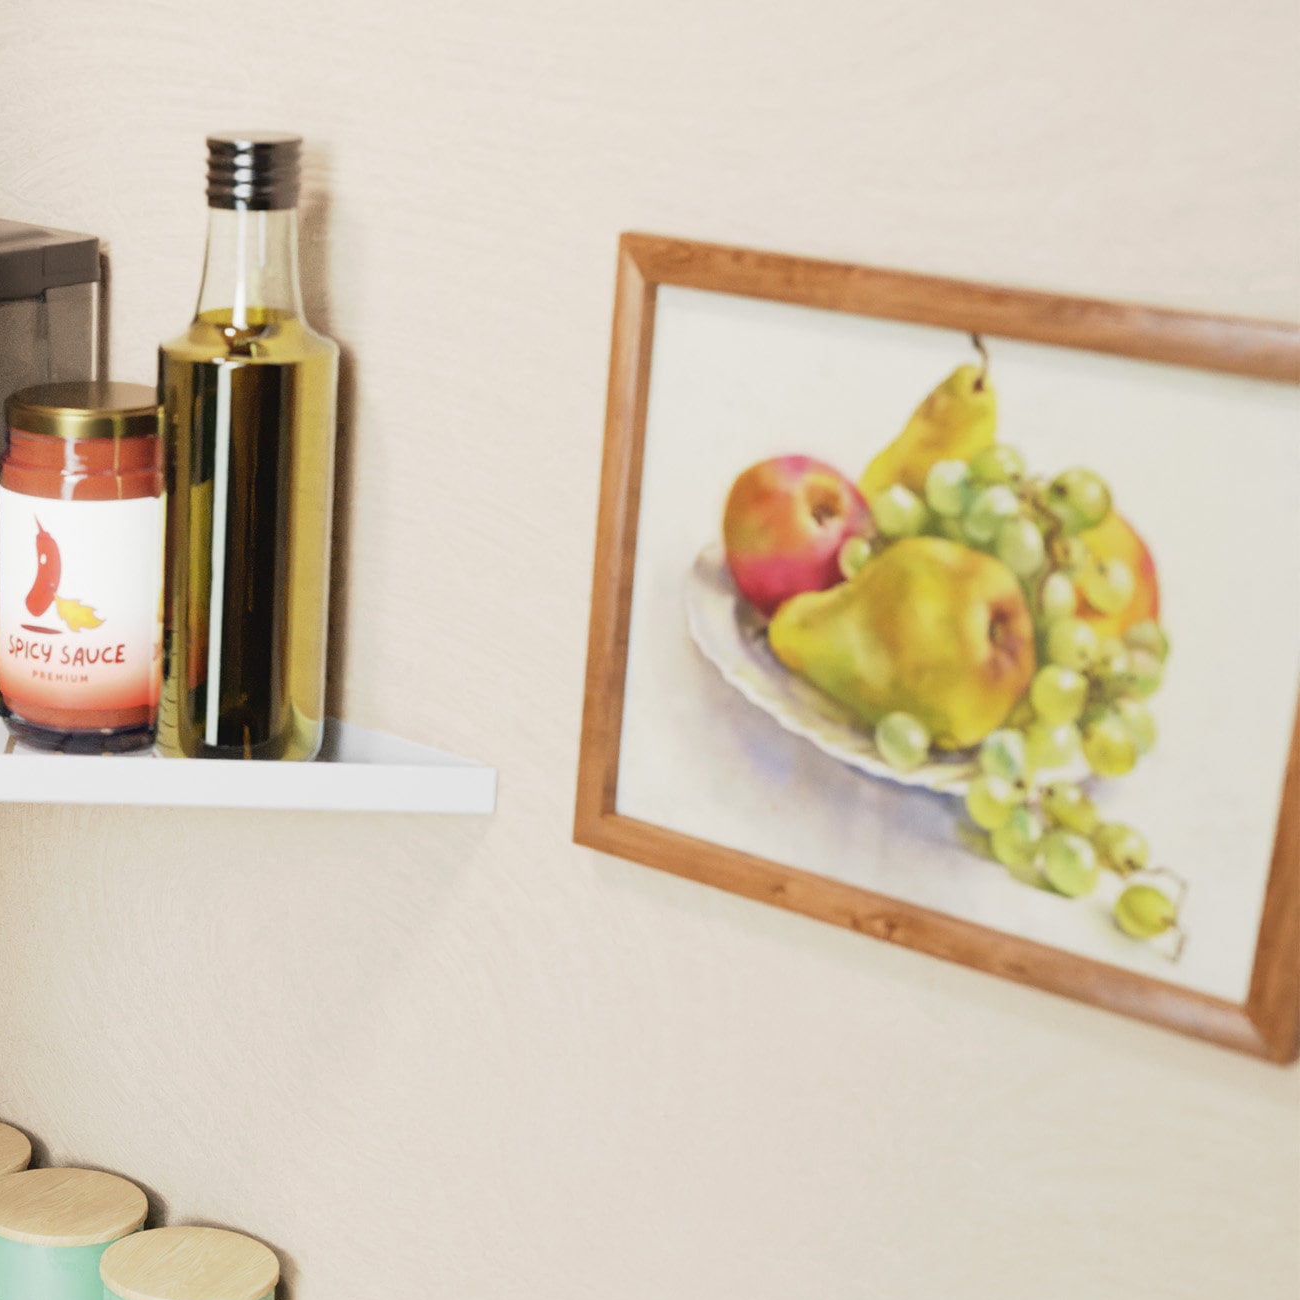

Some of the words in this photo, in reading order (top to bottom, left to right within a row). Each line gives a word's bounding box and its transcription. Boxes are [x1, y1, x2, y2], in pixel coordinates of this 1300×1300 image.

[8, 635, 53, 664] SPICY
[60, 644, 126, 667] SAUCE
[32, 670, 89, 683] PREMIUM
